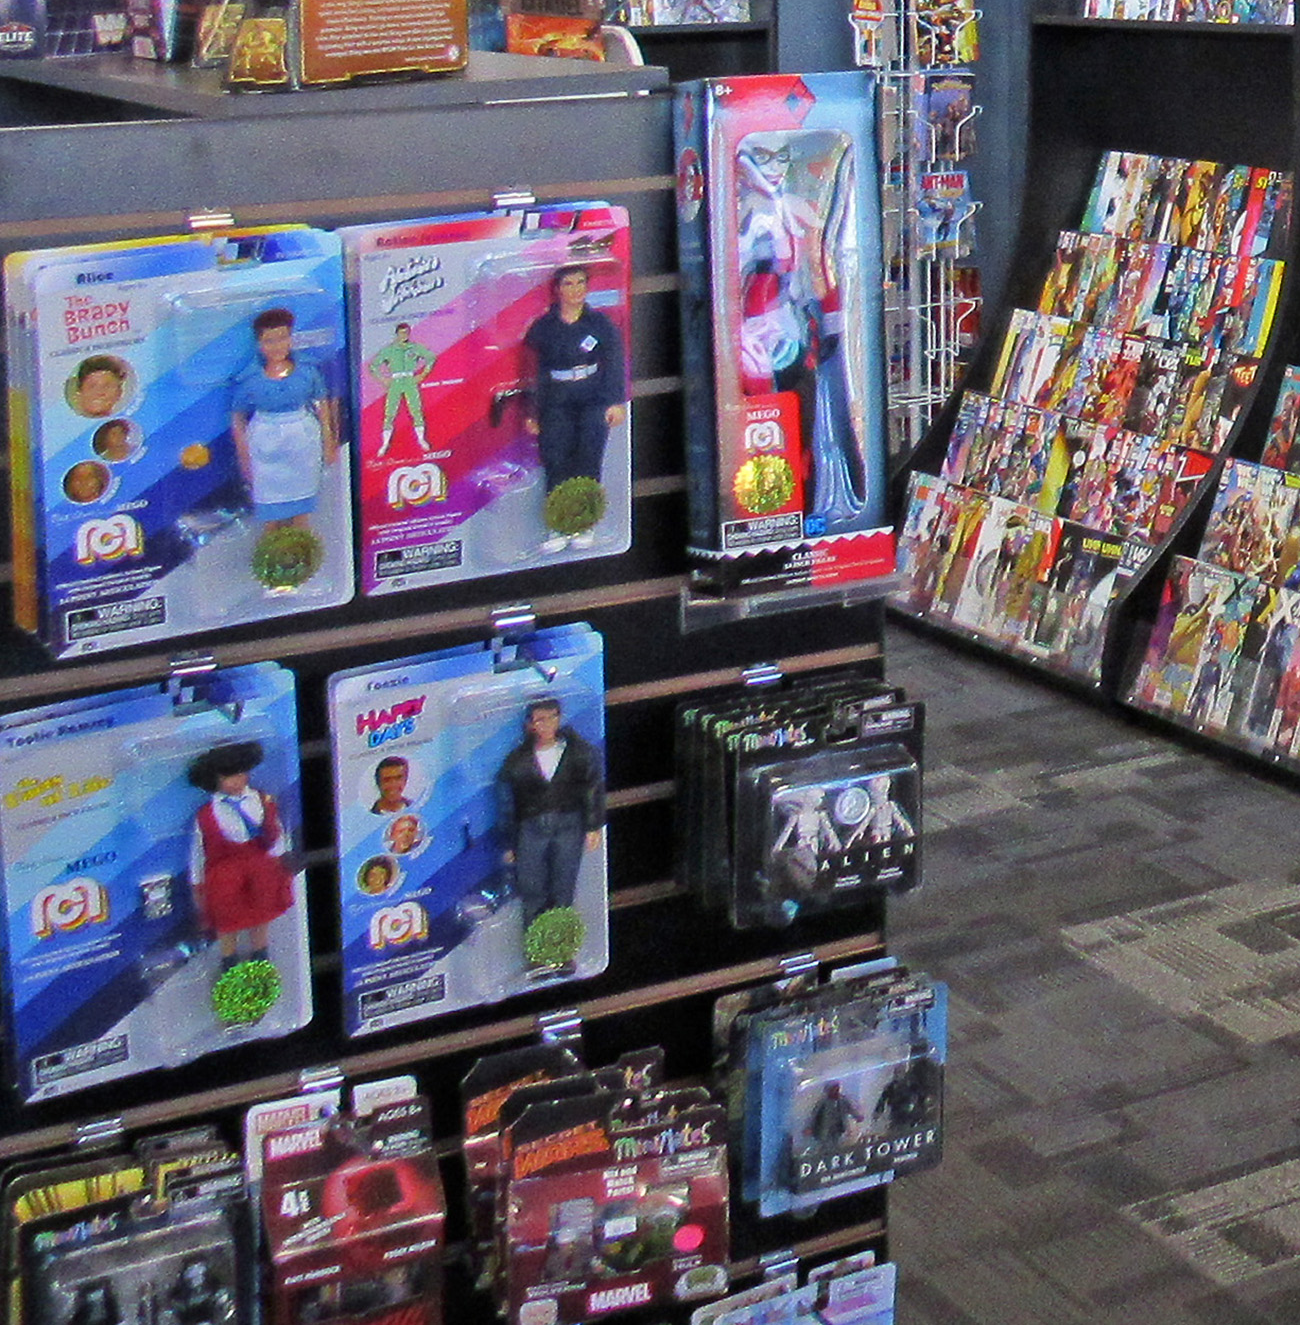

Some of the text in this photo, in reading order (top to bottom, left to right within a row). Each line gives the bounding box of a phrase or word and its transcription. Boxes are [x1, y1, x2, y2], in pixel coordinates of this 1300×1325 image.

[715, 85, 732, 97] 8+
[65, 295, 92, 307] The
[746, 409, 780, 420] MEGO
[356, 694, 427, 735] HAPPY
[367, 717, 416, 749] DAYS
[821, 844, 914, 870] ALIEN
[801, 1130, 937, 1177] DARK TOWER
[588, 1283, 651, 1312] MARVEL
